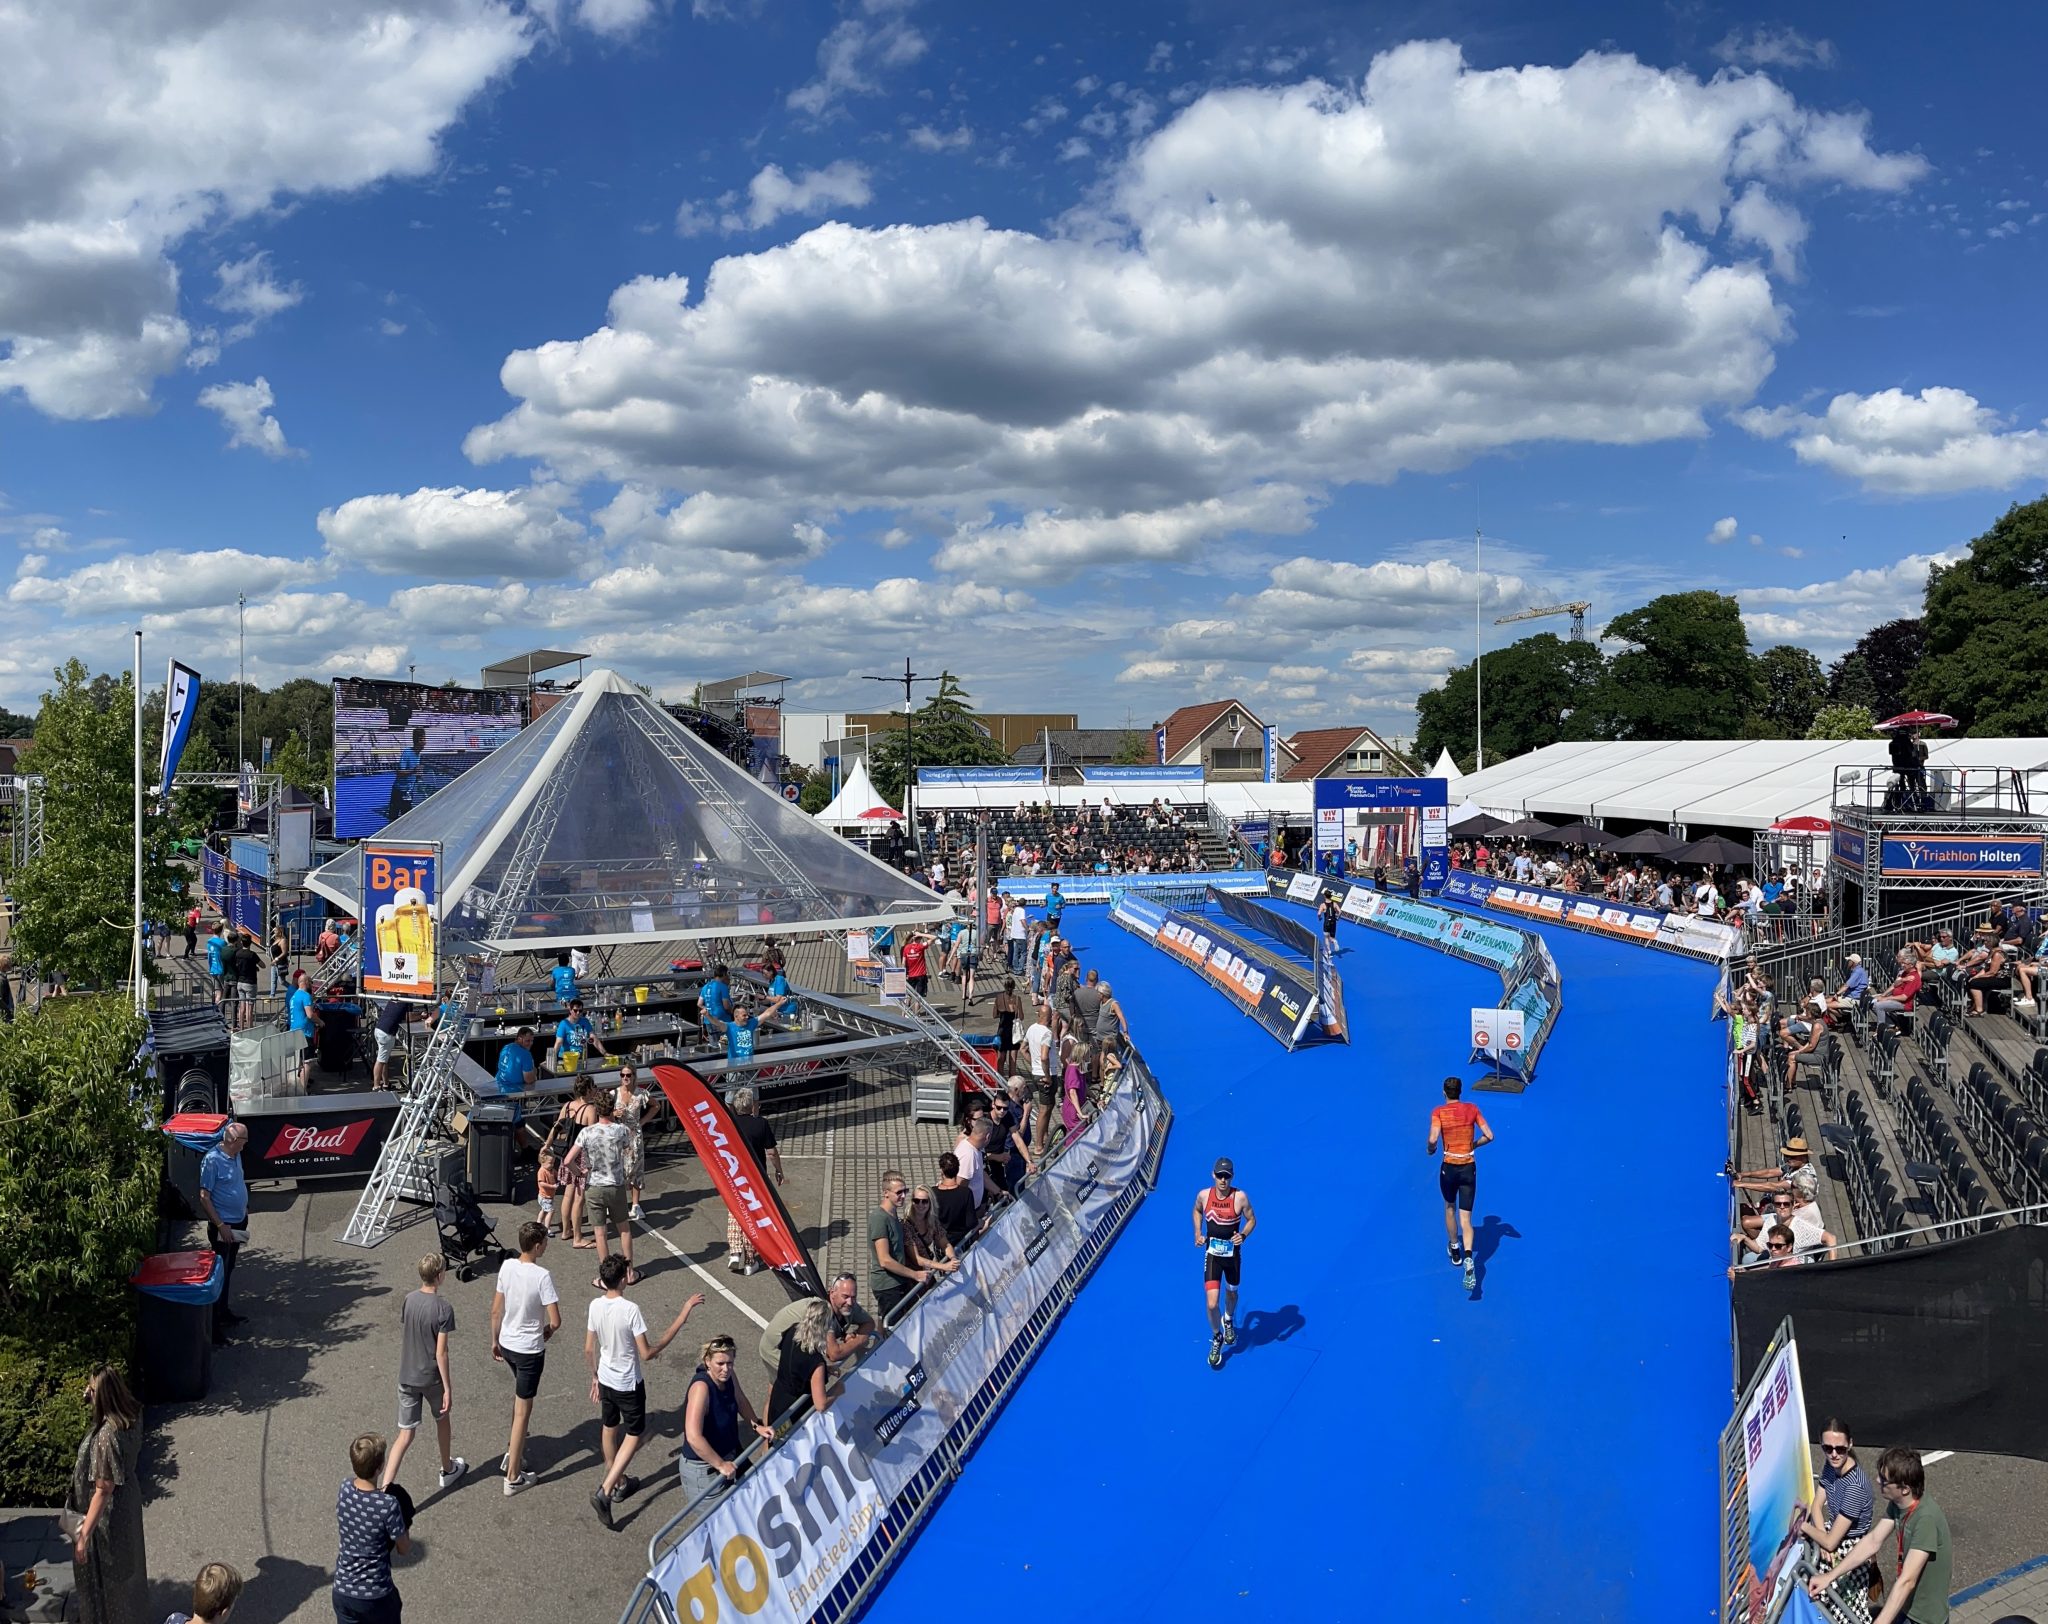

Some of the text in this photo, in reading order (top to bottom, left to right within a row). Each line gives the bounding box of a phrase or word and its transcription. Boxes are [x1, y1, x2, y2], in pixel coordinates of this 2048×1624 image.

[1923, 848, 2021, 863] Triathlon Holten
[372, 858, 427, 891] Bar
[1385, 907, 1438, 929] EAT OPENMINDED
[1461, 930, 1476, 942] EAT
[387, 971, 413, 981] Jupiler
[284, 1126, 349, 1152] Bud
[1040, 1217, 1052, 1230] Bos
[1774, 1358, 1789, 1415] VIER
[877, 1367, 925, 1440] Witteveen Bos
[1762, 1384, 1776, 1432] HET
[787, 1531, 848, 1614] financieel
